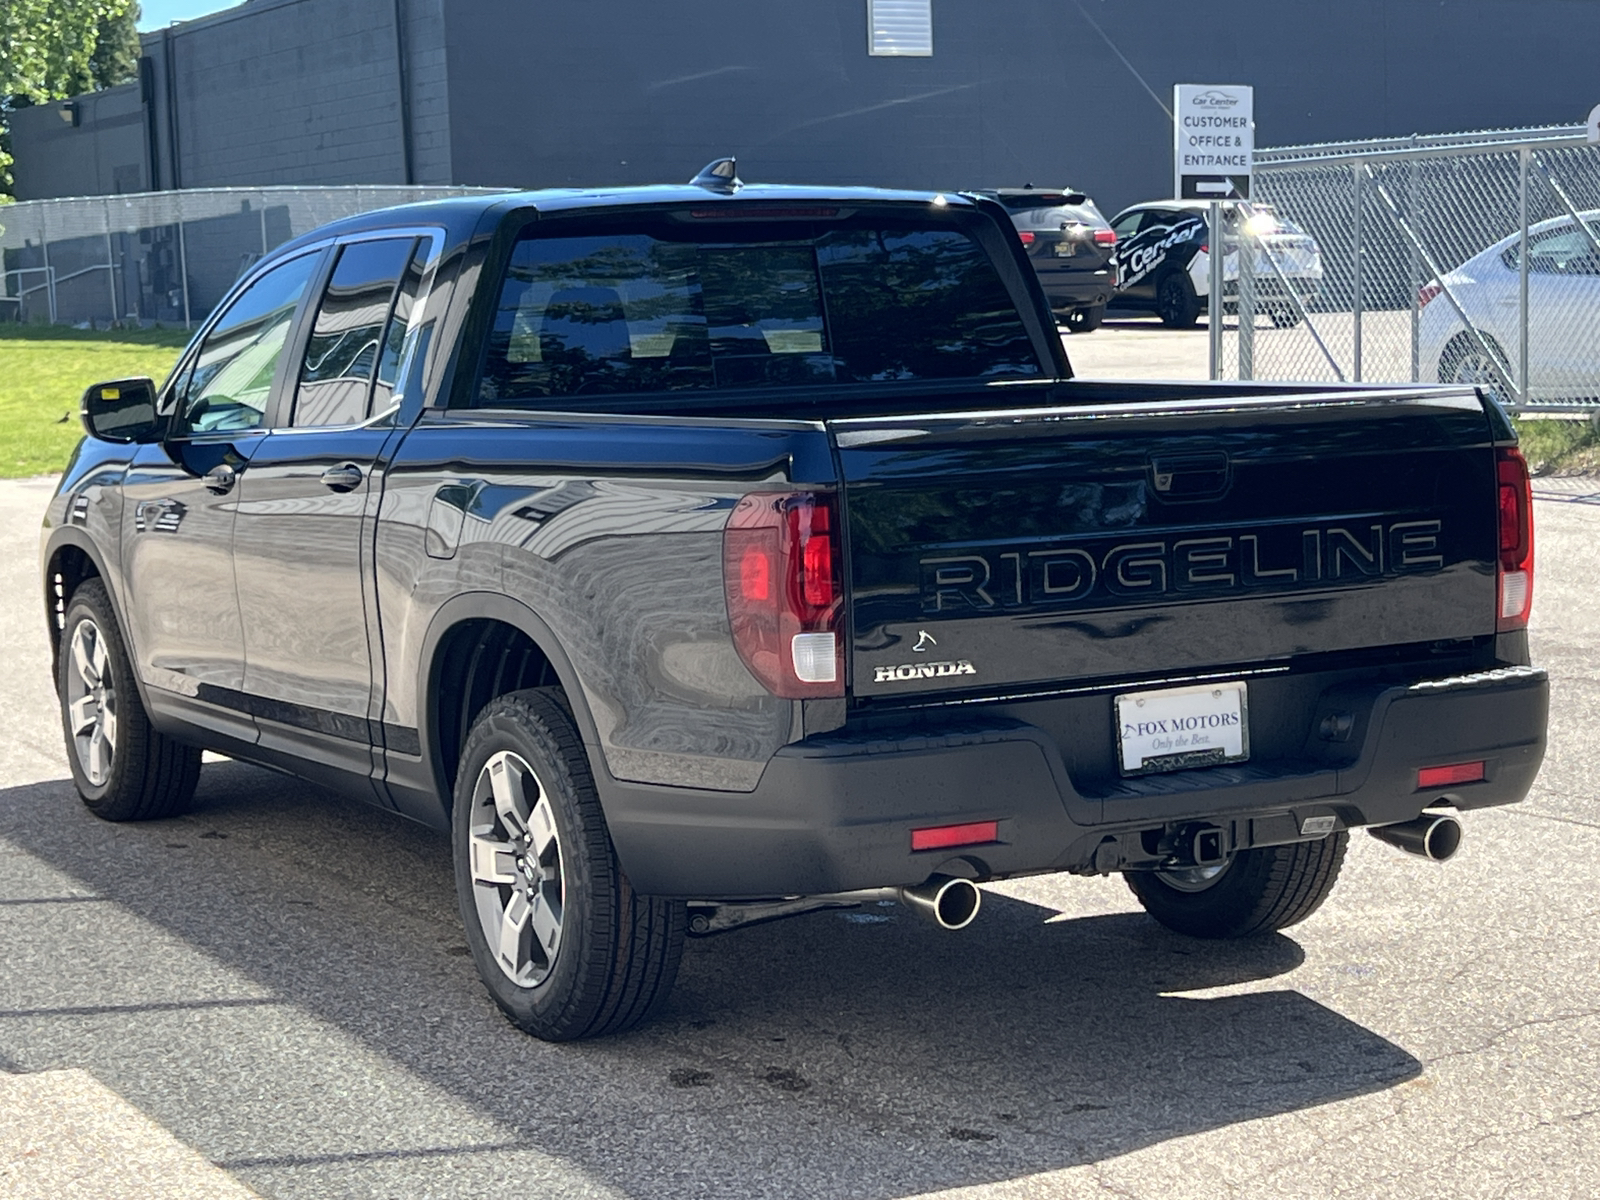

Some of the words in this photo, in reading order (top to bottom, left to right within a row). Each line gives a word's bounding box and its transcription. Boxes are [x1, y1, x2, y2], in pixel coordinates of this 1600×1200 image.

[1192, 98, 1207, 106] Car
[1209, 97, 1239, 106] Center
[1184, 116, 1247, 128] CUSTOMER
[1189, 135, 1231, 147] OFFICE
[1234, 136, 1242, 147] &
[1184, 155, 1247, 166] ENTRANCE
[1130, 222, 1203, 273] Center
[919, 519, 1443, 612] RIDGELINE
[873, 660, 977, 683] HONDA
[1138, 720, 1167, 736] FOX
[1171, 711, 1239, 732] MOTORS
[1152, 738, 1173, 751] Only
[1175, 734, 1188, 746] the
